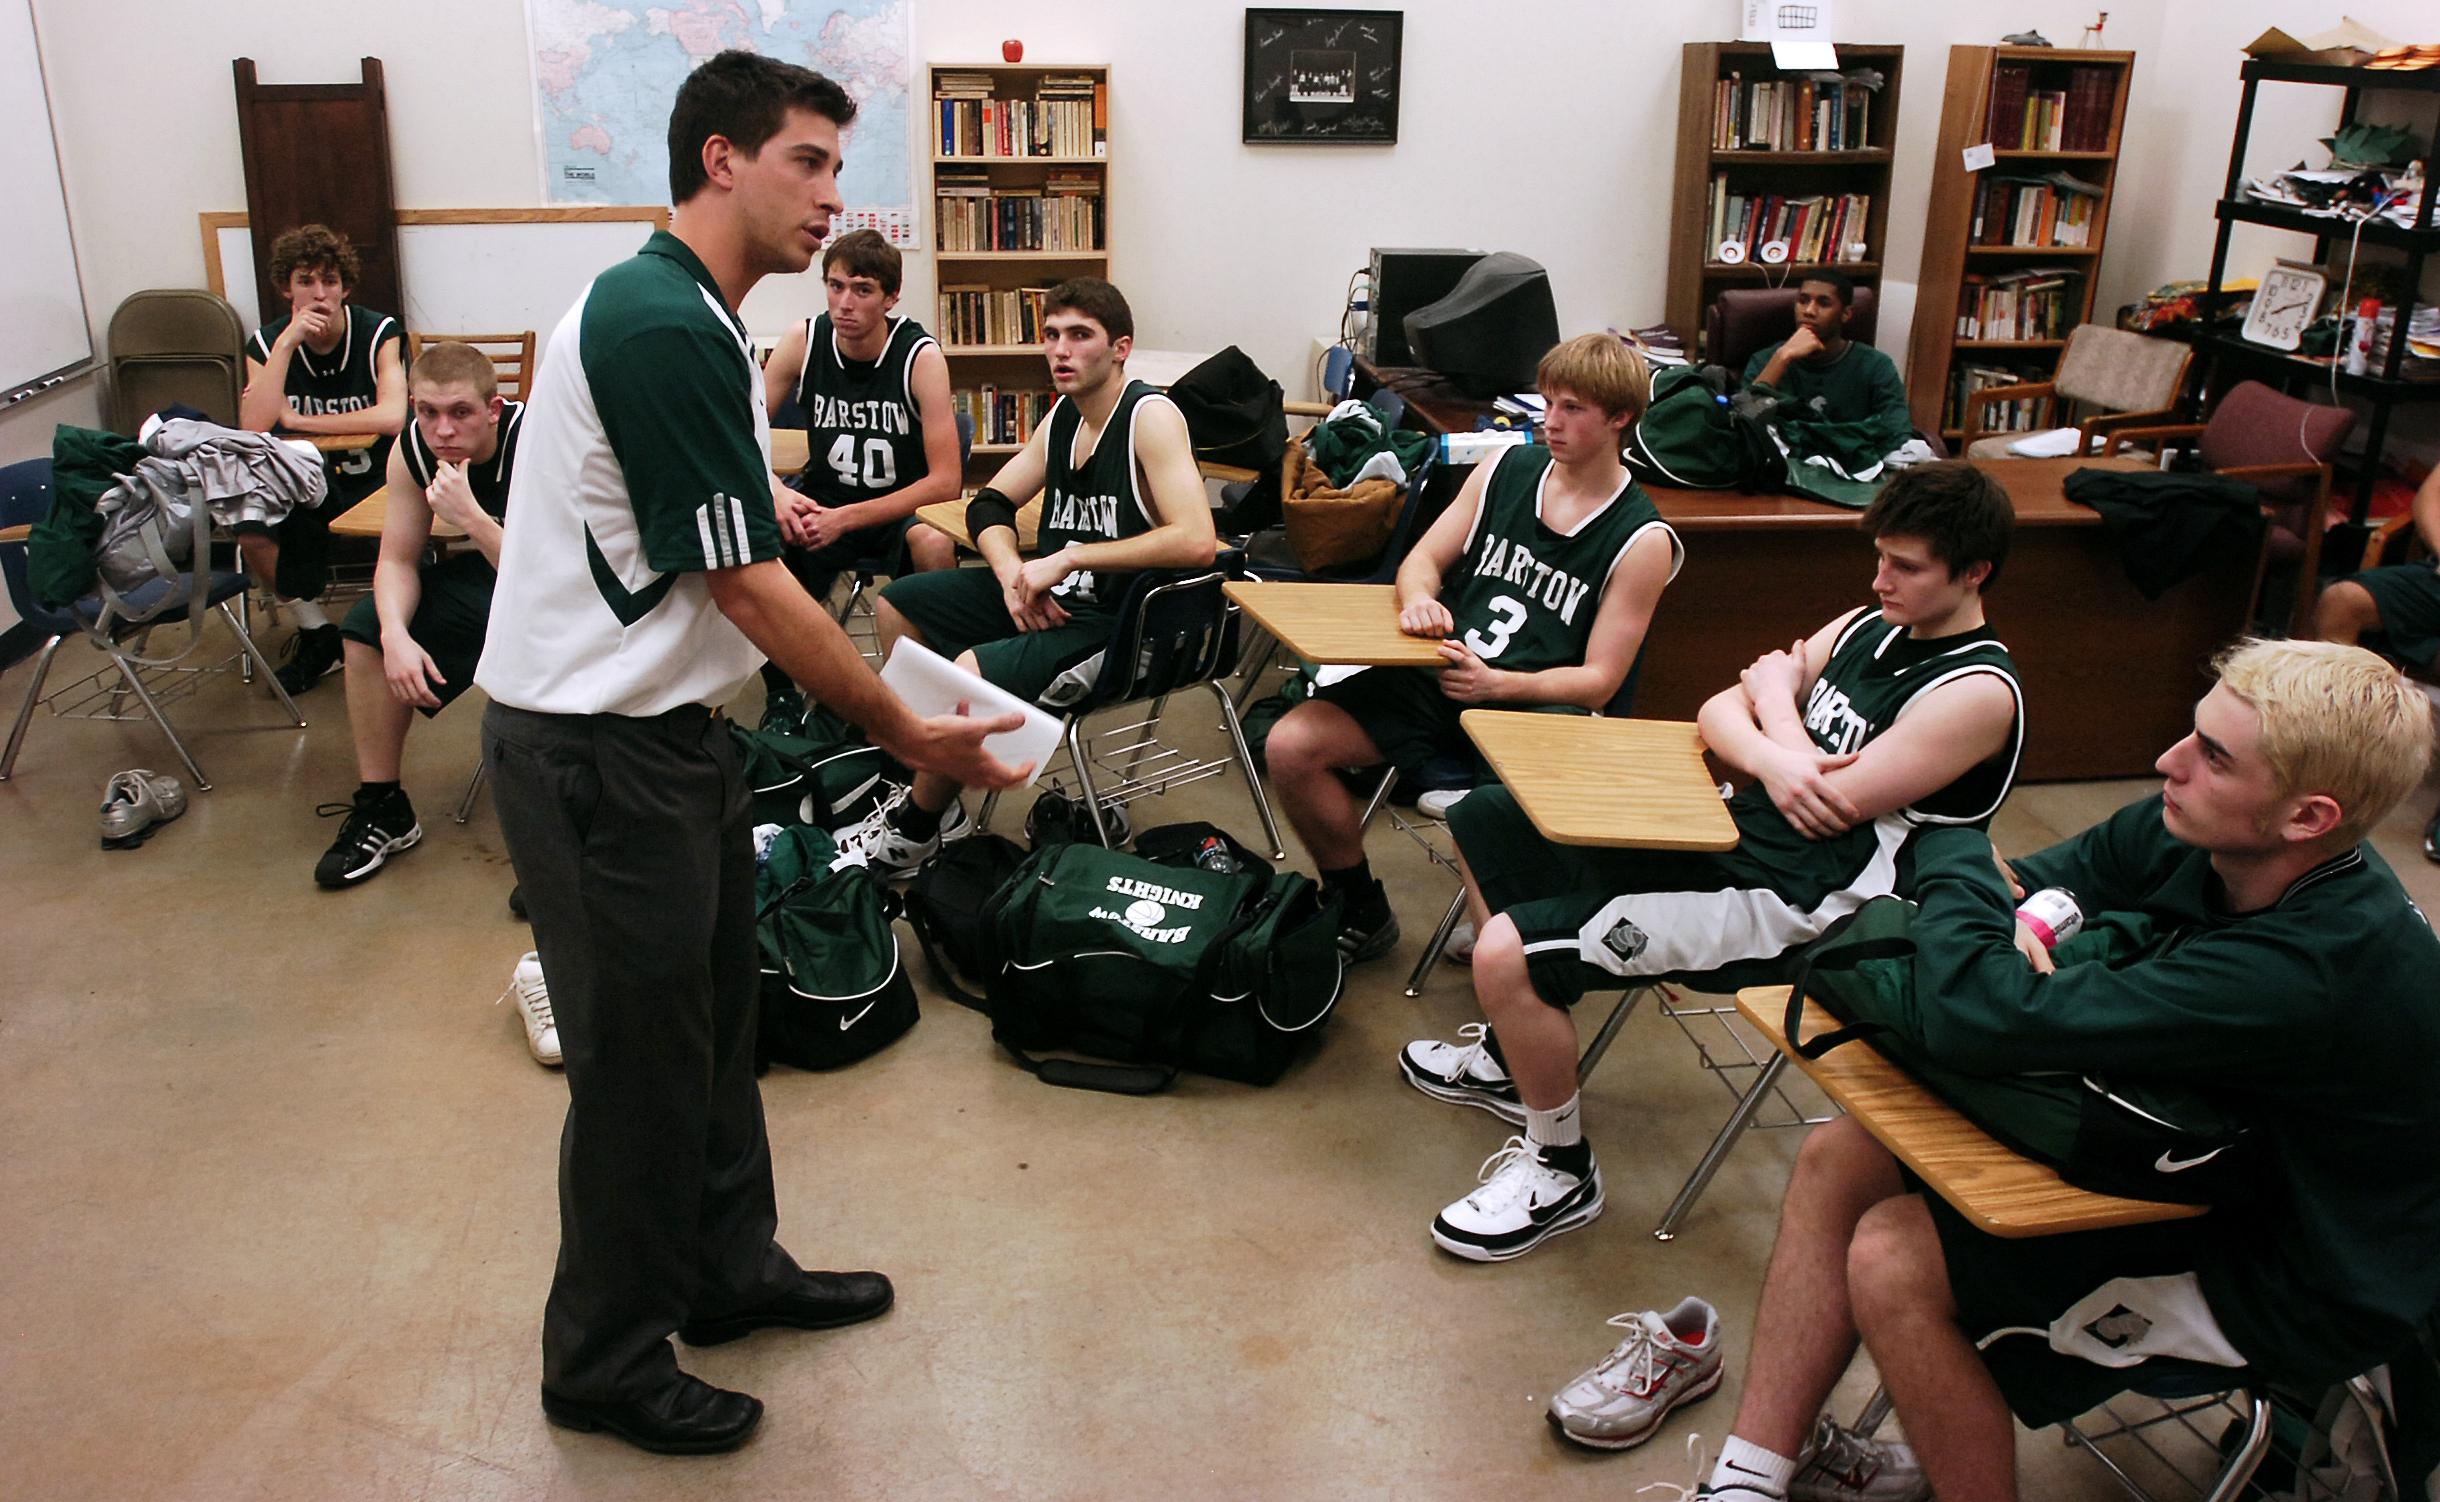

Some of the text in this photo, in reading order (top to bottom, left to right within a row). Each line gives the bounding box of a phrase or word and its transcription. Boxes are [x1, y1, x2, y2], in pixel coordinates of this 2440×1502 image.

[814, 393, 909, 435] BARSTOW
[827, 433, 897, 489] 40
[1474, 533, 1590, 626] BARTOW
[1464, 594, 1528, 659] 3
[1106, 876, 1204, 910] KNIGHTS
